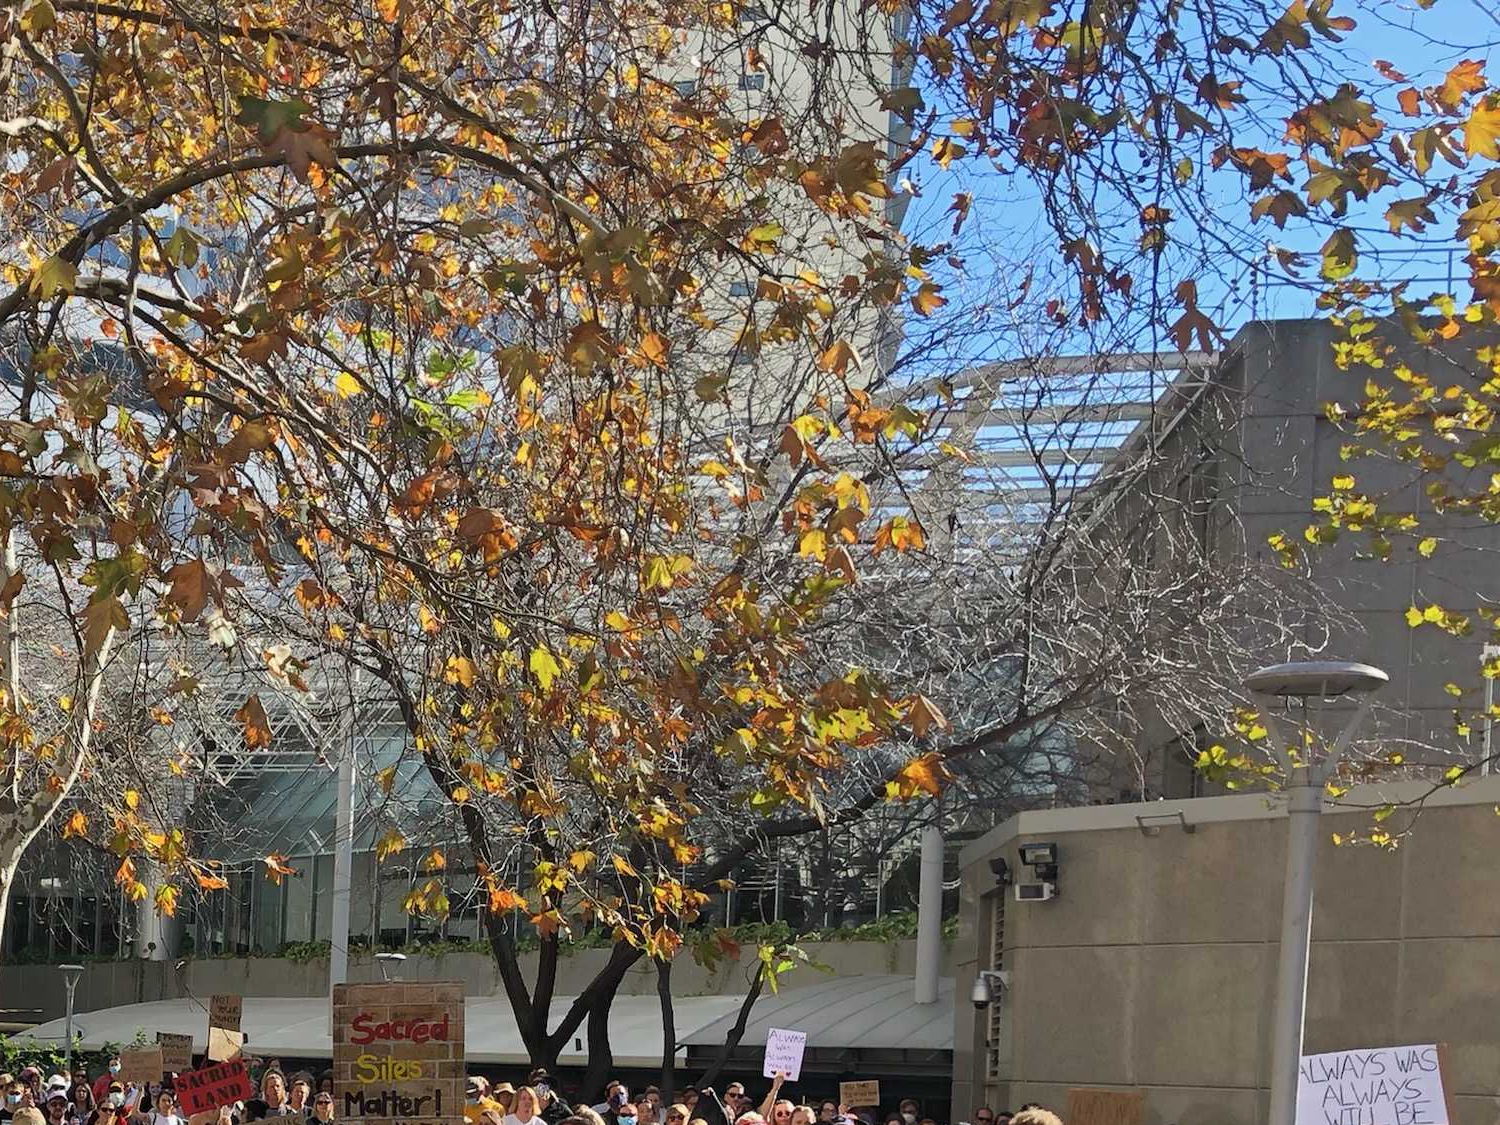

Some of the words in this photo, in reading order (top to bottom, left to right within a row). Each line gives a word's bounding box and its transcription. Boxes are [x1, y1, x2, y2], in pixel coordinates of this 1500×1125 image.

[351, 1012, 449, 1045] Sacred
[356, 1054, 422, 1084] Sites
[1394, 1048, 1437, 1073] WAS
[176, 1060, 242, 1091] SACRED
[192, 1082, 241, 1108] LAND
[345, 1089, 442, 1117] Matter!
[1322, 1078, 1422, 1108] ALWAYS
[1395, 1100, 1434, 1125] BE
